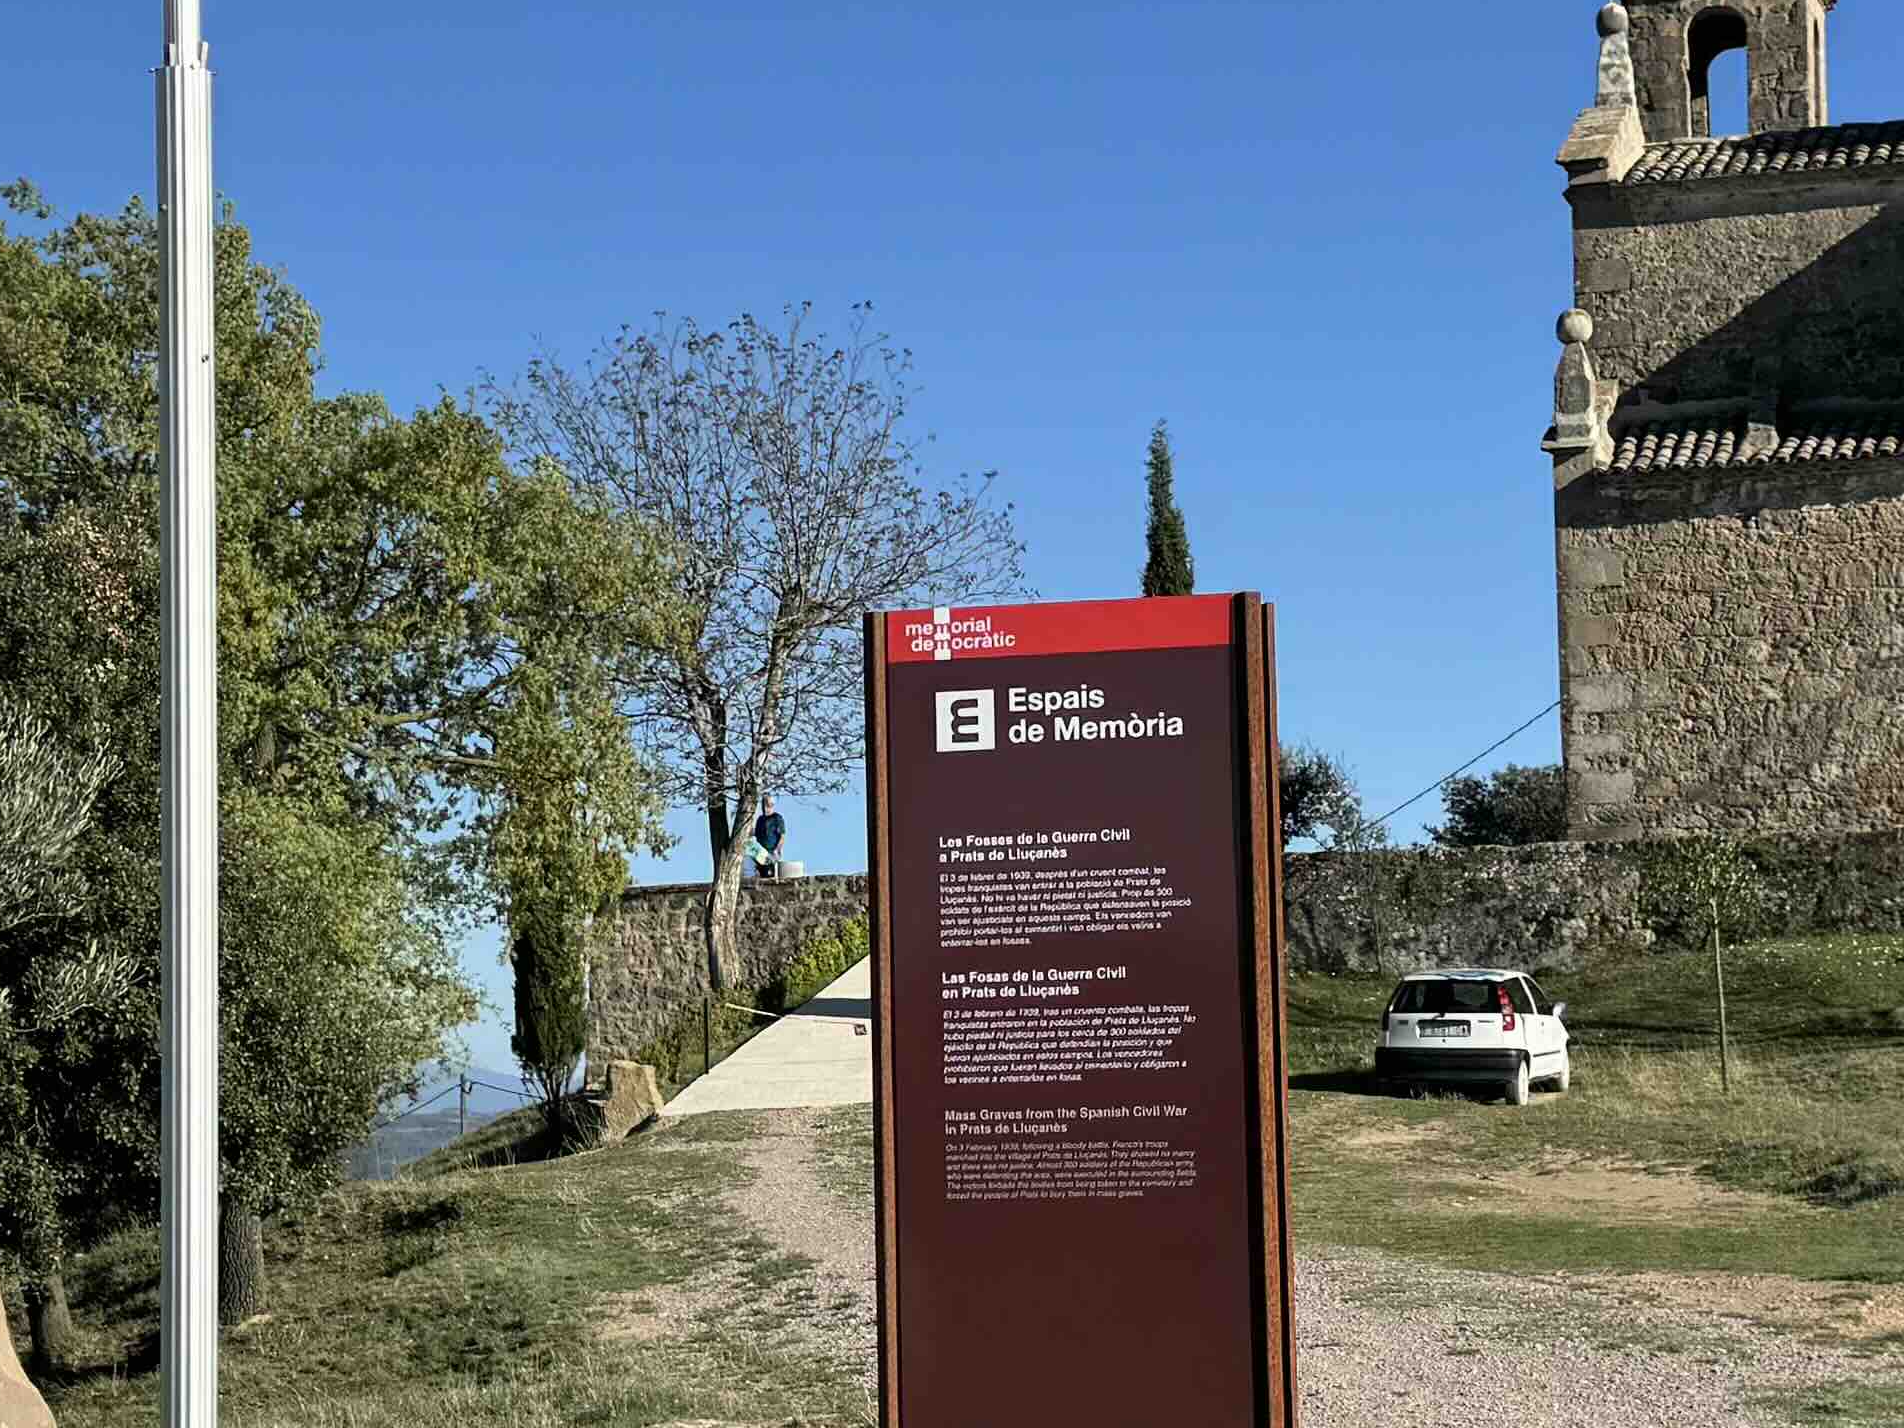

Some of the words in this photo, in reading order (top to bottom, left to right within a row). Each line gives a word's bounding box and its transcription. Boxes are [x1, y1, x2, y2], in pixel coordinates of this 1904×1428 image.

[1008, 684, 1105, 715] Espais
[1008, 719, 1045, 743] de
[1054, 712, 1184, 741] Memòria
[1016, 833, 1032, 845] de
[1036, 832, 1047, 844] la
[1051, 830, 1096, 843] Guerra
[1100, 828, 1130, 841] Civil
[950, 850, 984, 862] Prats
[988, 849, 1004, 860] de
[1008, 847, 1067, 860] Lluçanès
[942, 972, 965, 984] Las
[968, 970, 1008, 983] Fosas
[1012, 970, 1028, 982] de
[1032, 969, 1043, 981] la
[1047, 968, 1092, 981] Guerra
[1096, 966, 1126, 979] Civil
[942, 989, 957, 999] en
[961, 986, 996, 998] Prats
[999, 986, 1016, 997] de
[945, 1110, 976, 1120] Mass
[979, 1109, 1022, 1120] Graves
[1026, 1110, 1053, 1119] from
[1057, 1108, 1075, 1118] the
[1079, 1107, 1129, 1118] Spanish
[1133, 1106, 1160, 1116] Civil
[1163, 1105, 1187, 1116] War
[959, 1123, 991, 1134] Prats
[994, 1124, 1009, 1133] de
